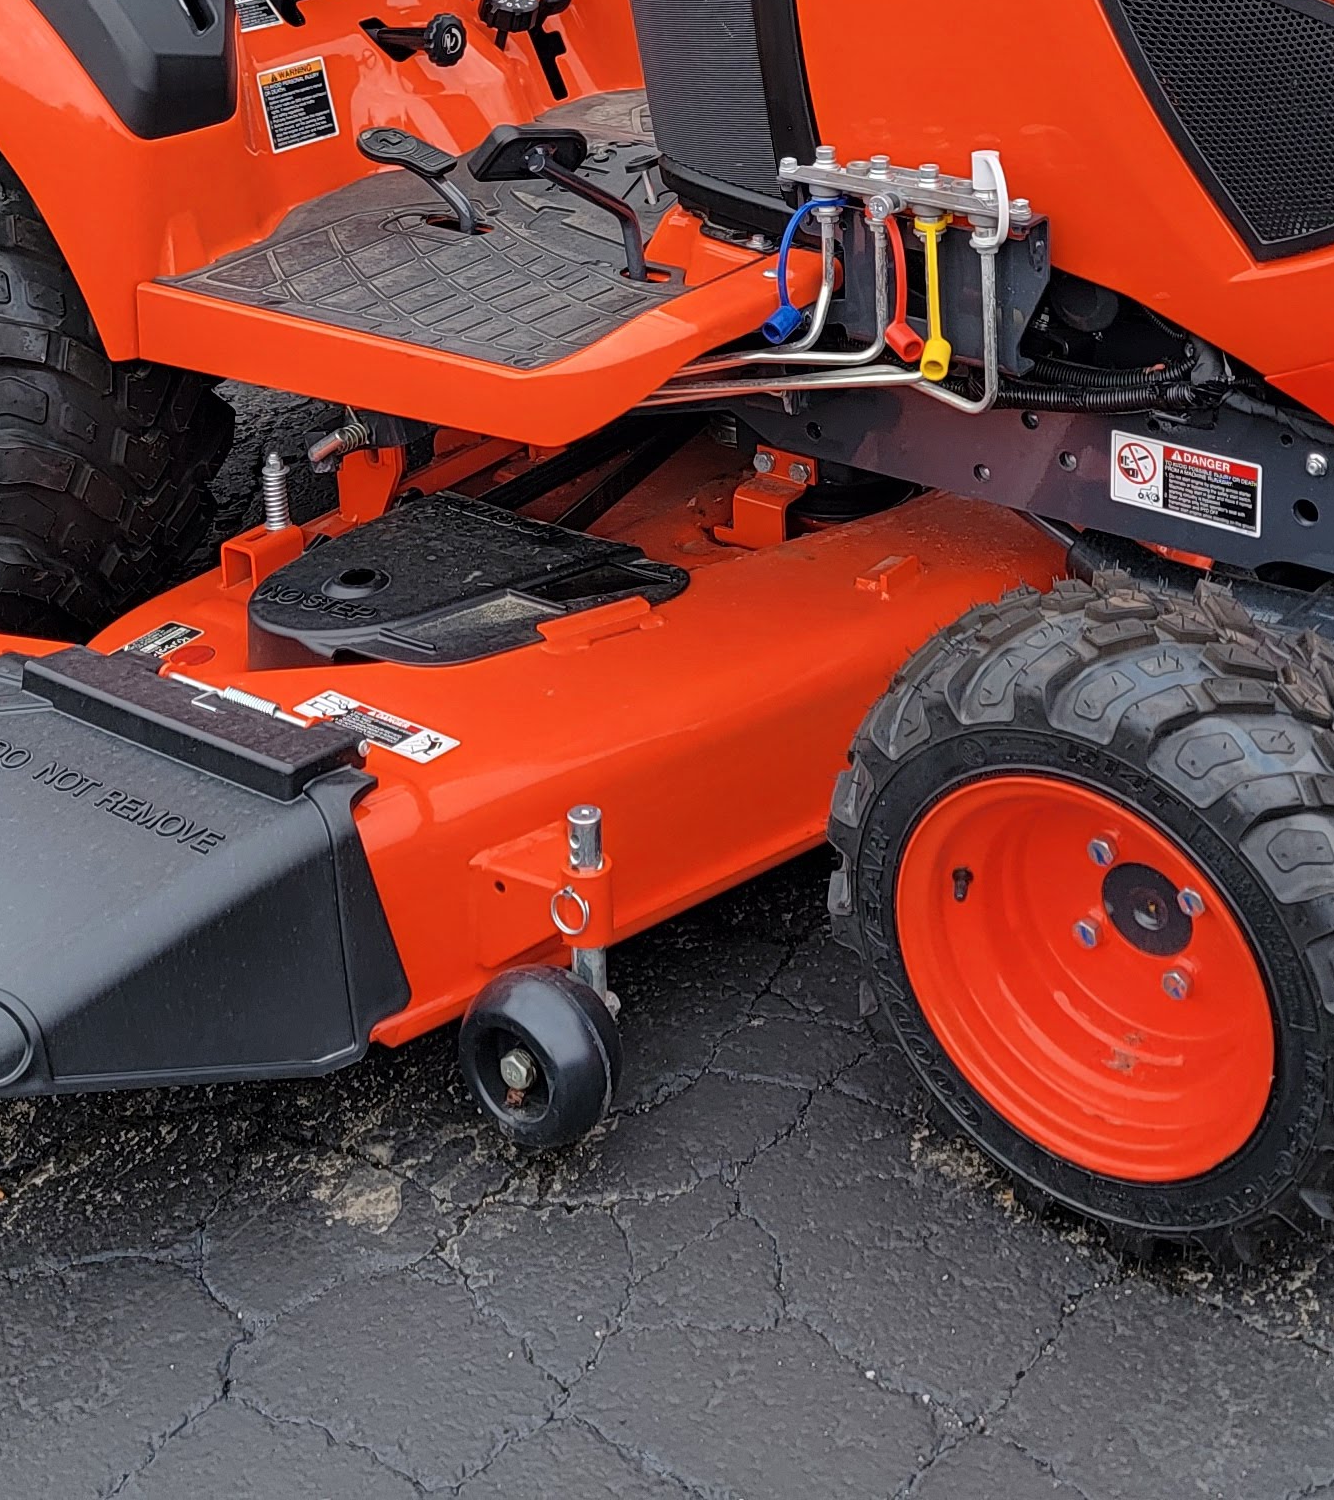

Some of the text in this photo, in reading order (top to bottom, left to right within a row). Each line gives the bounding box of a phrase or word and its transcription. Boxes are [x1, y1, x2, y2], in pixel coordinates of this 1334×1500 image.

[278, 63, 313, 80] WARNING
[1183, 453, 1231, 473] DANGER
[256, 583, 378, 620] NO STEP
[32, 760, 104, 797] NOT
[94, 789, 226, 855] REMOVE
